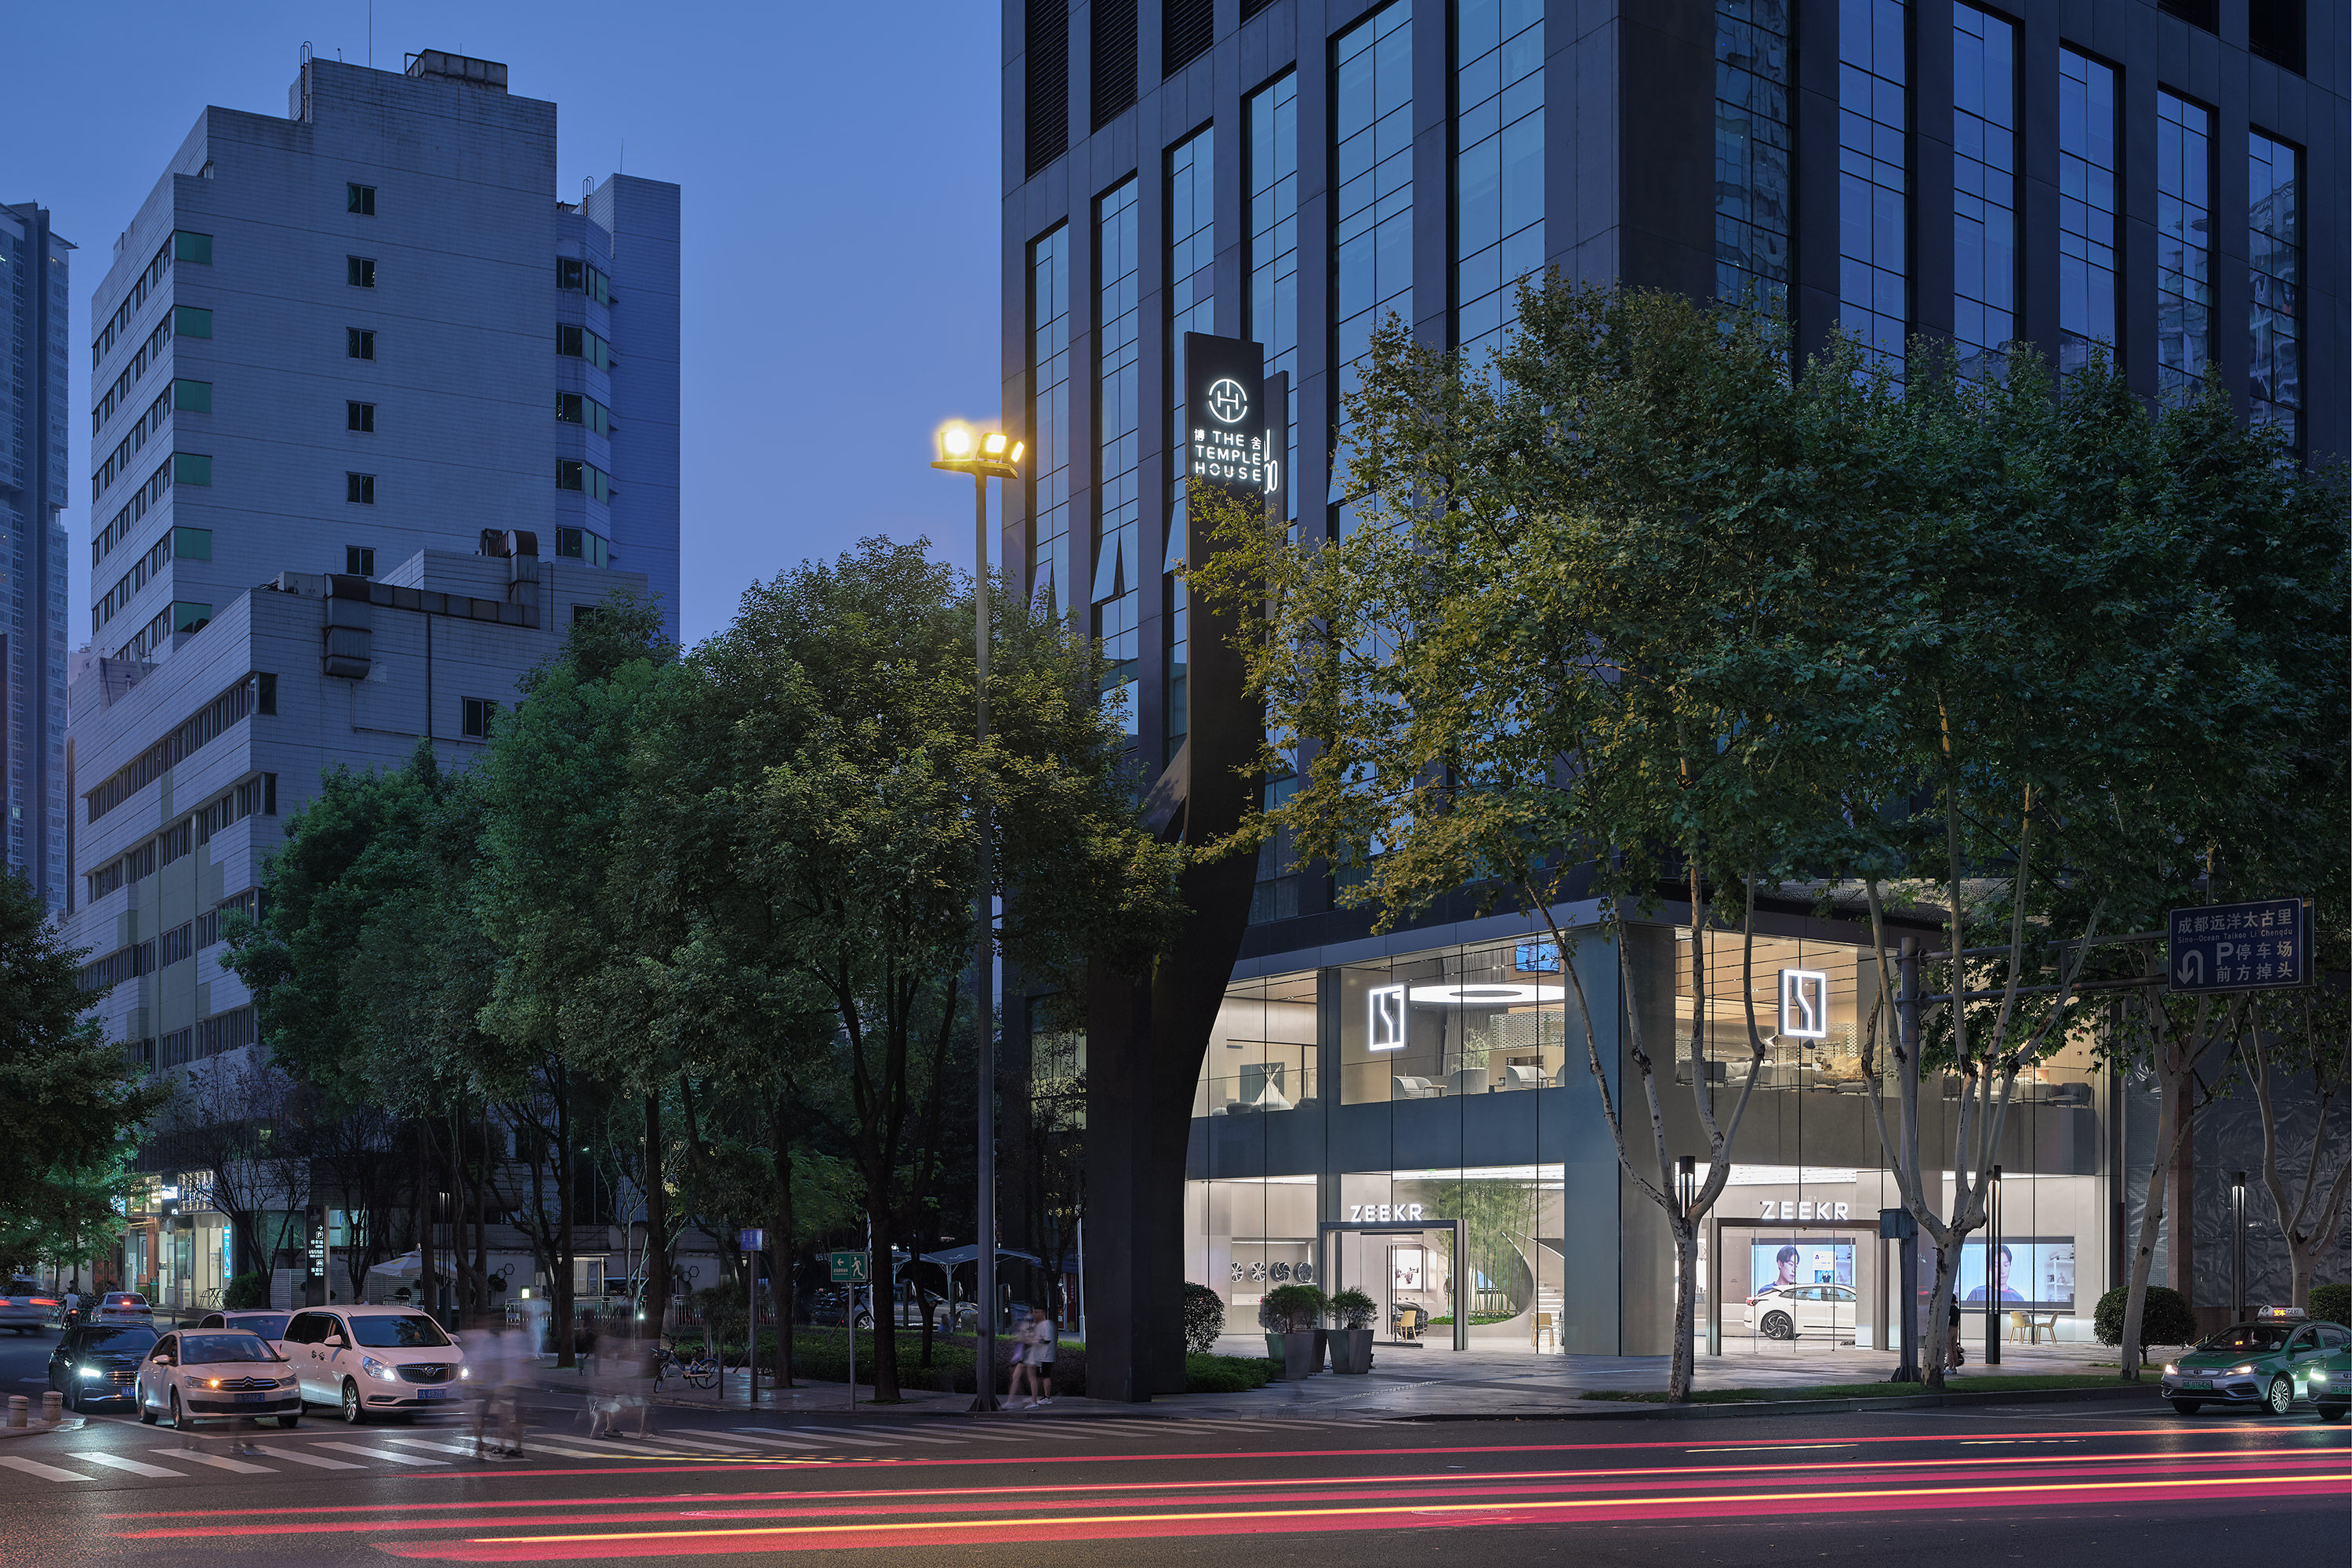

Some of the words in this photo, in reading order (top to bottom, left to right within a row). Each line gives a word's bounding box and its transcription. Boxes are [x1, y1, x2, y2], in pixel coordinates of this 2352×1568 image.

[1212, 430, 1245, 447] THE
[1250, 436, 1261, 450] 舍
[1195, 445, 1261, 465] TEMPLE
[1195, 461, 1261, 482] HOUSE
[2177, 908, 2292, 935] 成都远洋太古里
[2223, 931, 2247, 940] Taikoo
[2260, 928, 2292, 938] Chengdu
[2216, 942, 2234, 966] P
[2235, 940, 2292, 961] 停车场
[2216, 961, 2293, 983] 前方掉头
[1350, 1203, 1424, 1222] ZEEKR
[1760, 1201, 1849, 1220] ZEEKR
